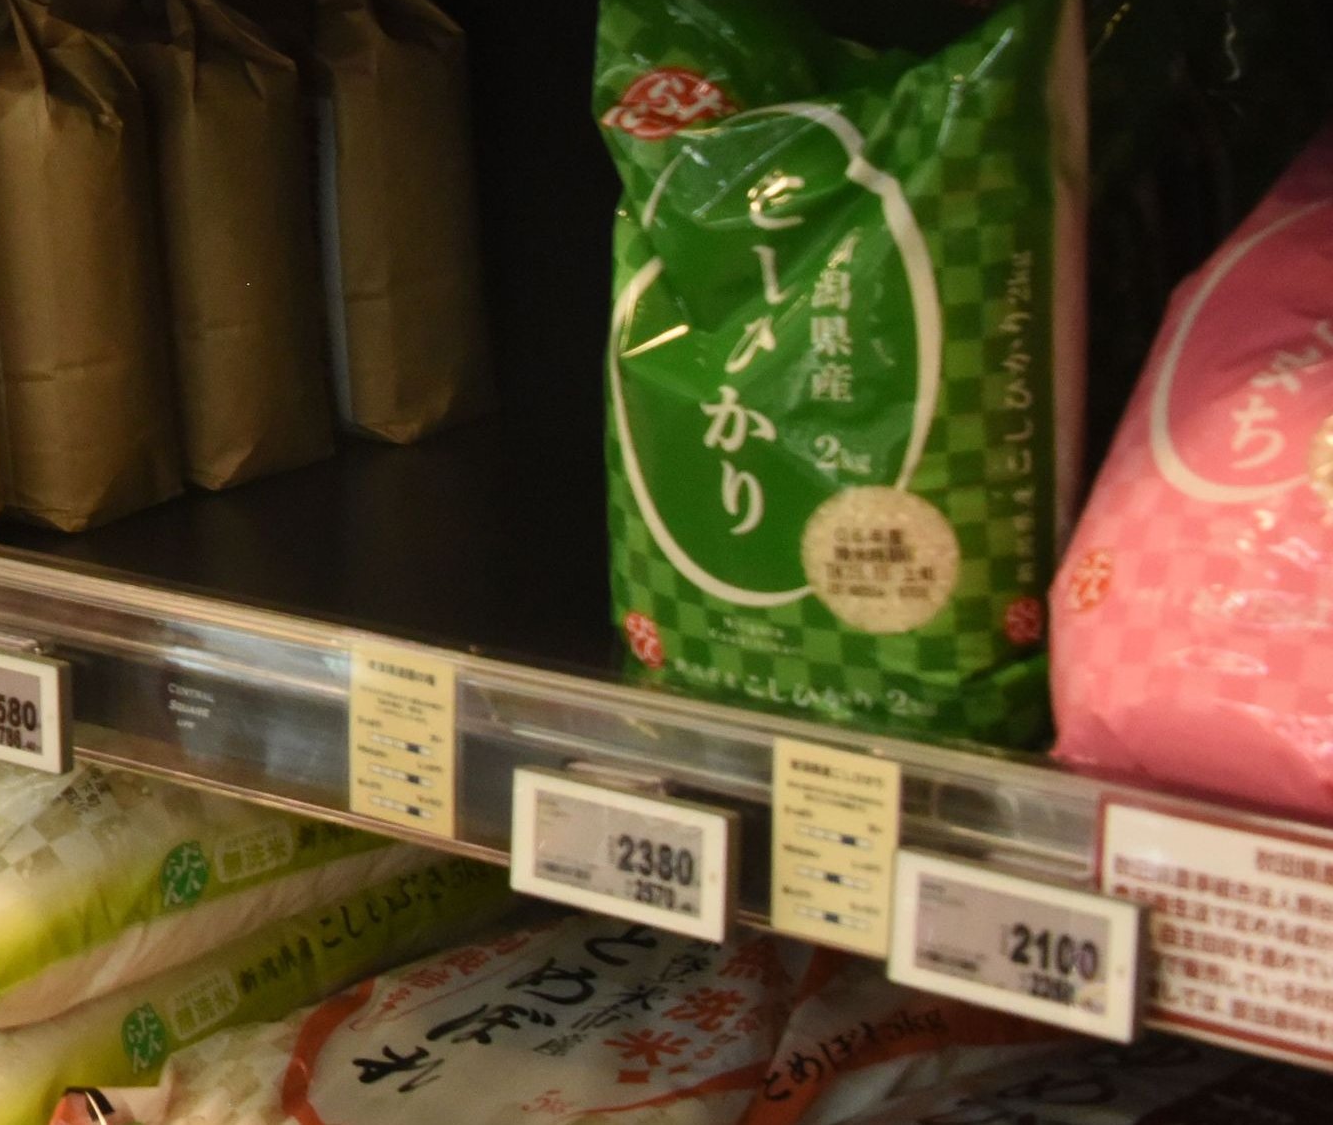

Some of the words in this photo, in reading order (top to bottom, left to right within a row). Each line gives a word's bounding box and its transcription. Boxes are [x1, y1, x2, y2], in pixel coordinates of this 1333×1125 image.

[810, 229, 862, 405] 潟県産
[166, 682, 216, 704] CENTRAL
[167, 697, 211, 719] SQUARE
[617, 832, 696, 888] 2380
[1012, 923, 1100, 982] 2100
